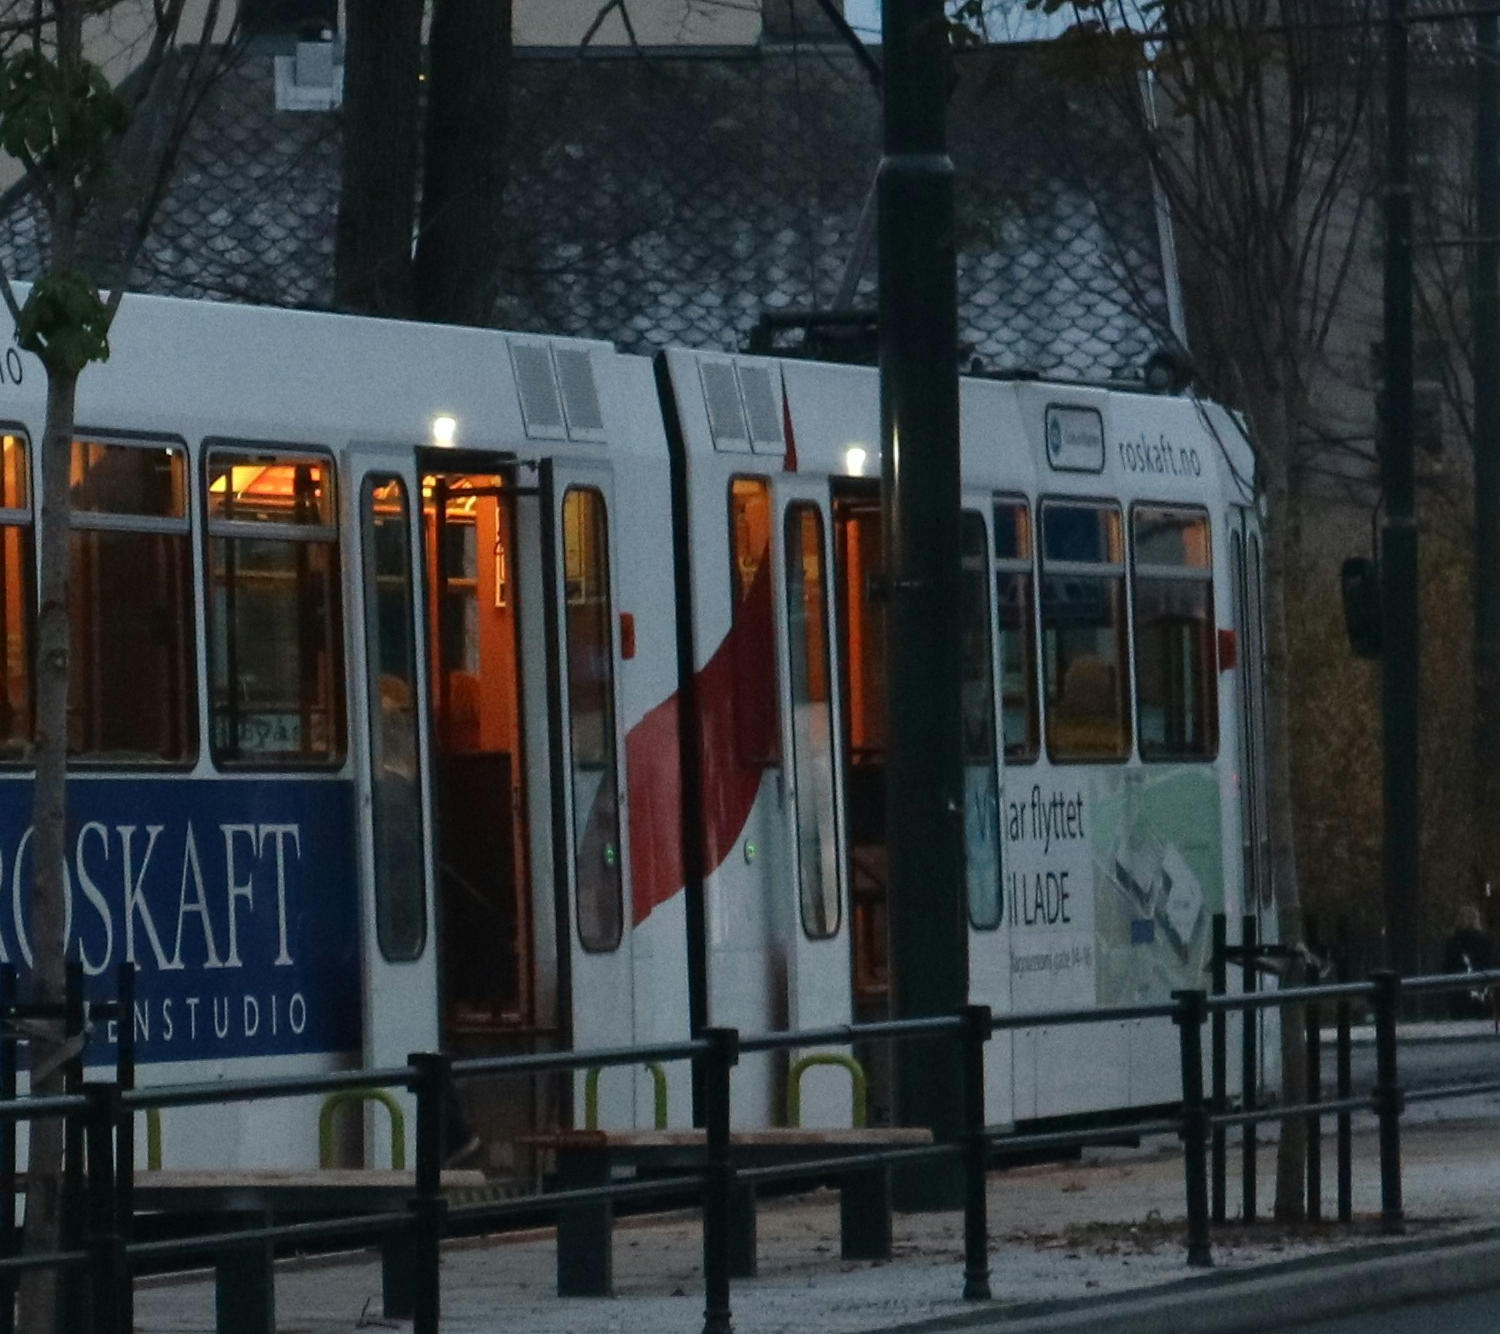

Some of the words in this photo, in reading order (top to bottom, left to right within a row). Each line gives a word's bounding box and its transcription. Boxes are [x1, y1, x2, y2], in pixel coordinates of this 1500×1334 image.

[1118, 431, 1201, 477] roskaft.no
[1006, 799, 1026, 843] ar
[1031, 783, 1085, 855] flyttet
[1023, 871, 1071, 925] LADE
